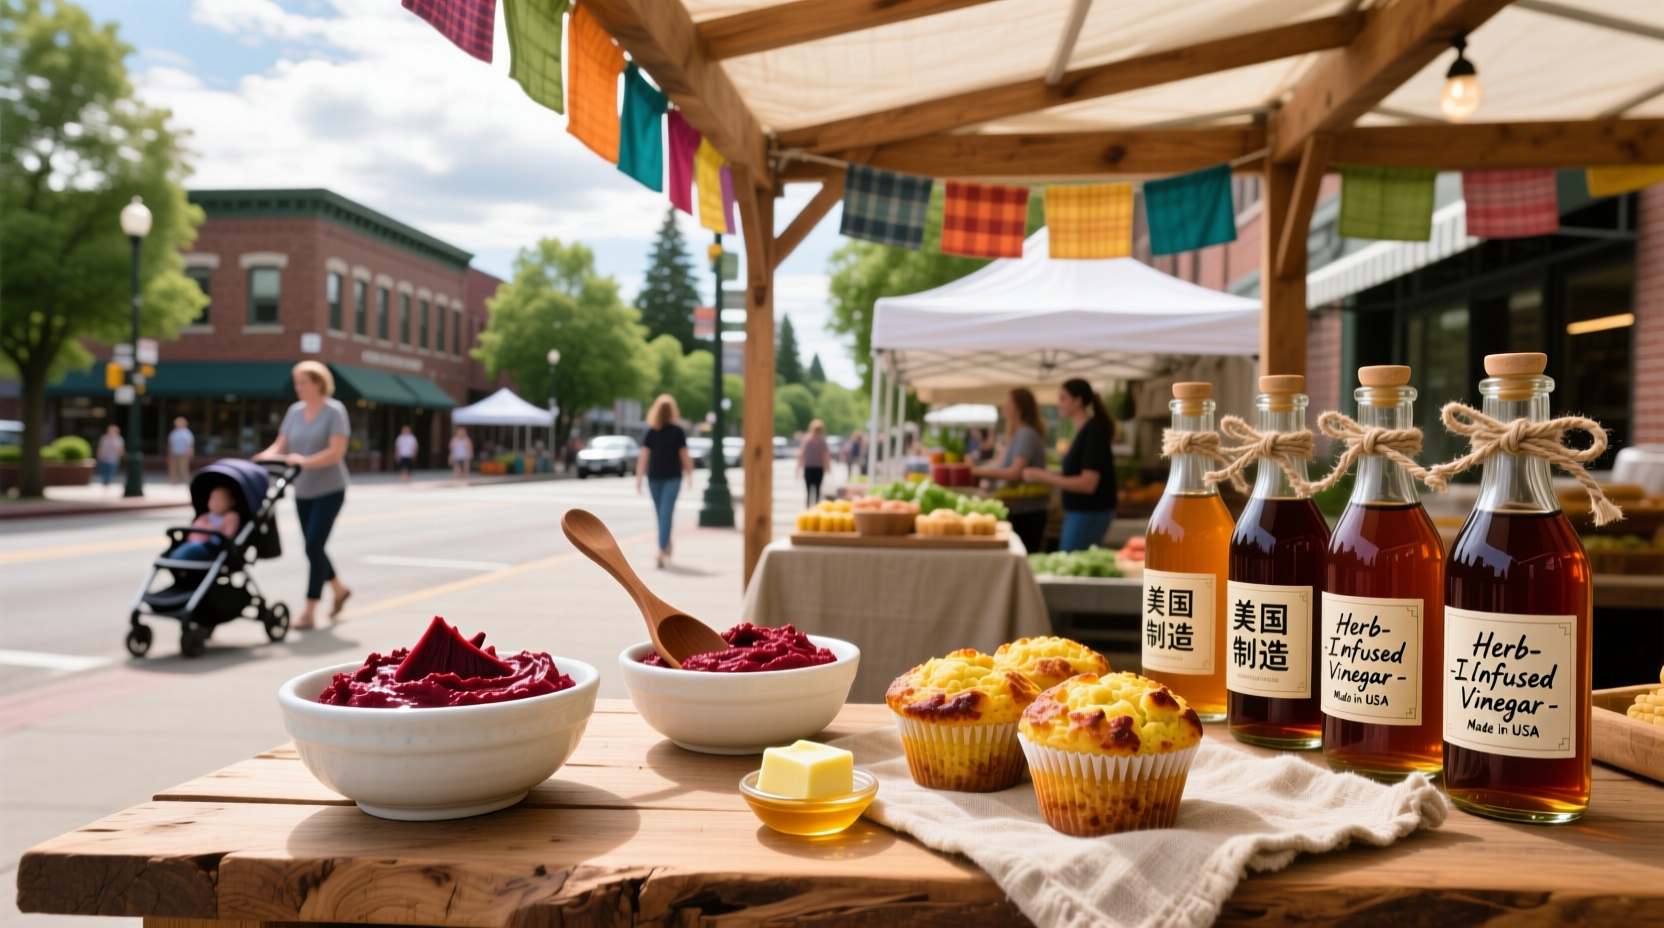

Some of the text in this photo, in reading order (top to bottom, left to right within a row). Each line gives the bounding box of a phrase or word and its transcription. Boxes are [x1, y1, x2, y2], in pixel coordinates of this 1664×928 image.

[1147, 585, 1193, 618] 美国
[1233, 599, 1288, 636] 美国
[1147, 619, 1194, 652] 制造
[1336, 612, 1391, 637] Herb-
[1233, 635, 1289, 672] 制造
[1472, 631, 1541, 660] Herb-
[1329, 660, 1393, 692] Vinegar
[1354, 693, 1362, 704] in
[1366, 694, 1389, 707] USA
[1461, 685, 1544, 723] Vinegar
[1498, 723, 1508, 735] in
[1512, 724, 1540, 739] USA
